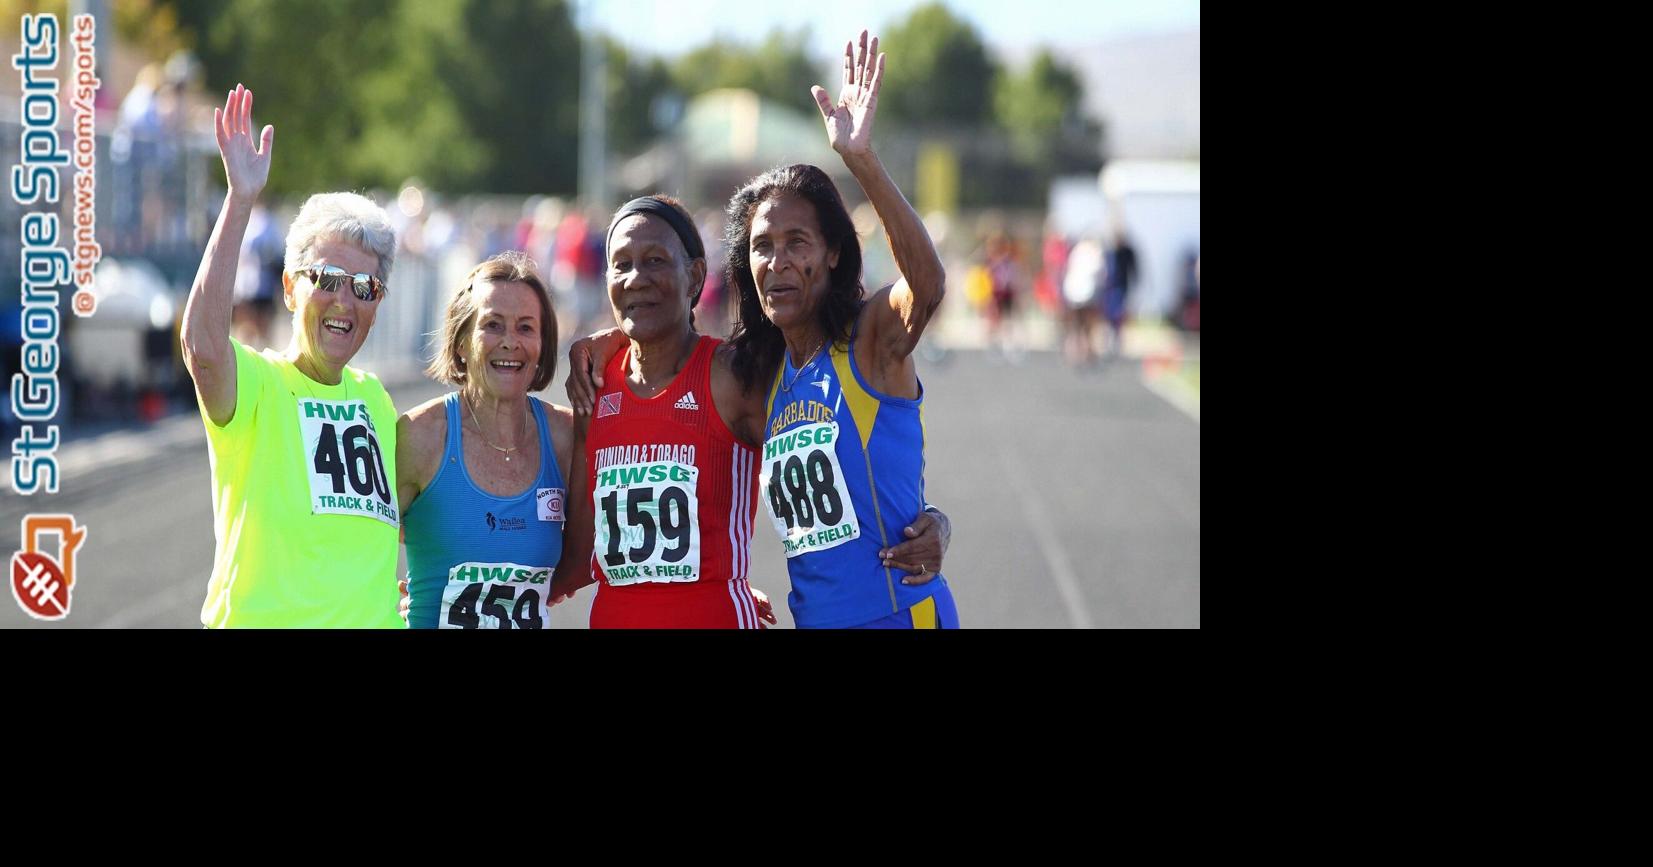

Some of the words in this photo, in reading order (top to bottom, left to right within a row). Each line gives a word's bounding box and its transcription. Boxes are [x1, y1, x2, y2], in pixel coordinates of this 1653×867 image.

[674, 402, 699, 410] adidas
[771, 399, 834, 438] BARBADOS
[766, 427, 832, 460] HWSG
[314, 423, 391, 505] 460
[594, 445, 639, 470] TRINIDAD
[640, 444, 648, 464] &
[650, 444, 695, 466] TOBAGO
[600, 466, 690, 487] HWSG
[769, 449, 843, 528] 488
[319, 496, 362, 510] TRACK
[366, 499, 374, 511] &
[377, 502, 397, 521] FIELD
[601, 486, 690, 566] 159
[807, 534, 816, 546] &
[817, 523, 852, 544] FIELD
[456, 566, 549, 584] HWSG
[607, 566, 641, 579] TRACK
[643, 565, 652, 576] &
[656, 565, 692, 576] FIELD
